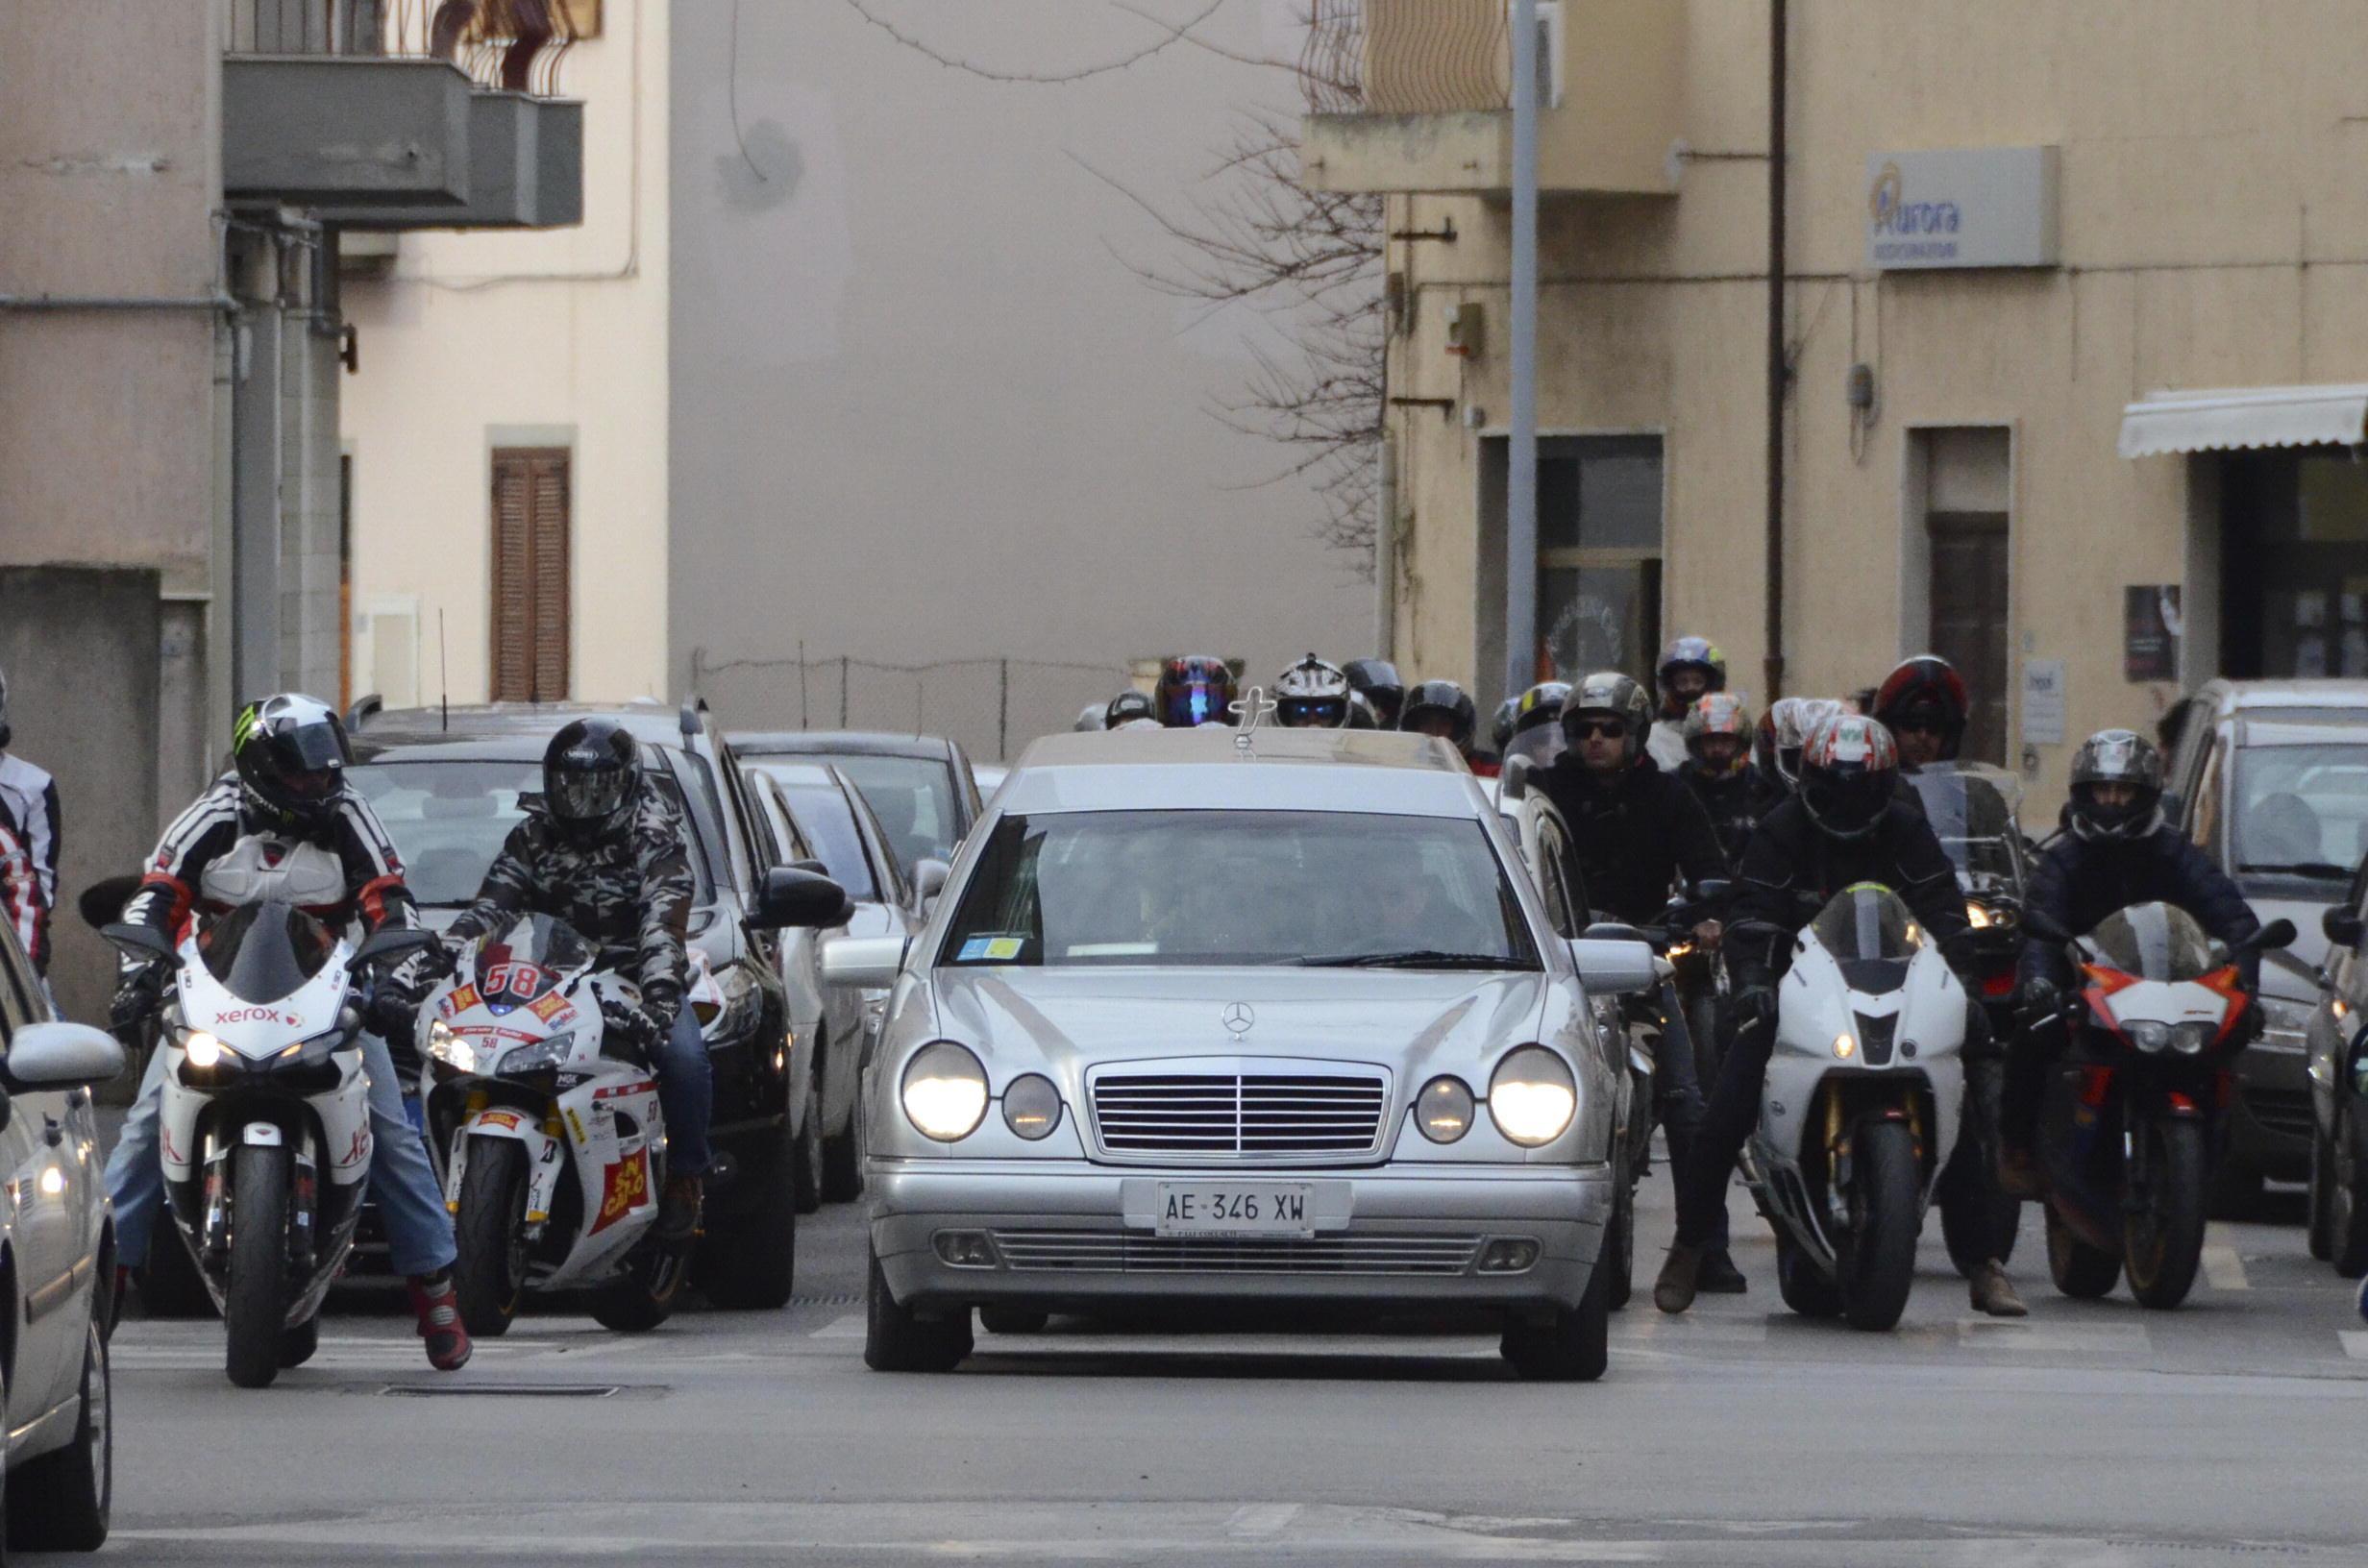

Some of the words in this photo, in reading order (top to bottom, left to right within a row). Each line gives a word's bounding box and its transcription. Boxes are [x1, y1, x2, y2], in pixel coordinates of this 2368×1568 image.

[483, 964, 540, 998] 58
[215, 1007, 279, 1024] xerox
[481, 1037, 499, 1049] 58
[1165, 1193, 1196, 1220] AE
[1212, 1193, 1259, 1220] 346
[1274, 1194, 1304, 1220] XW
